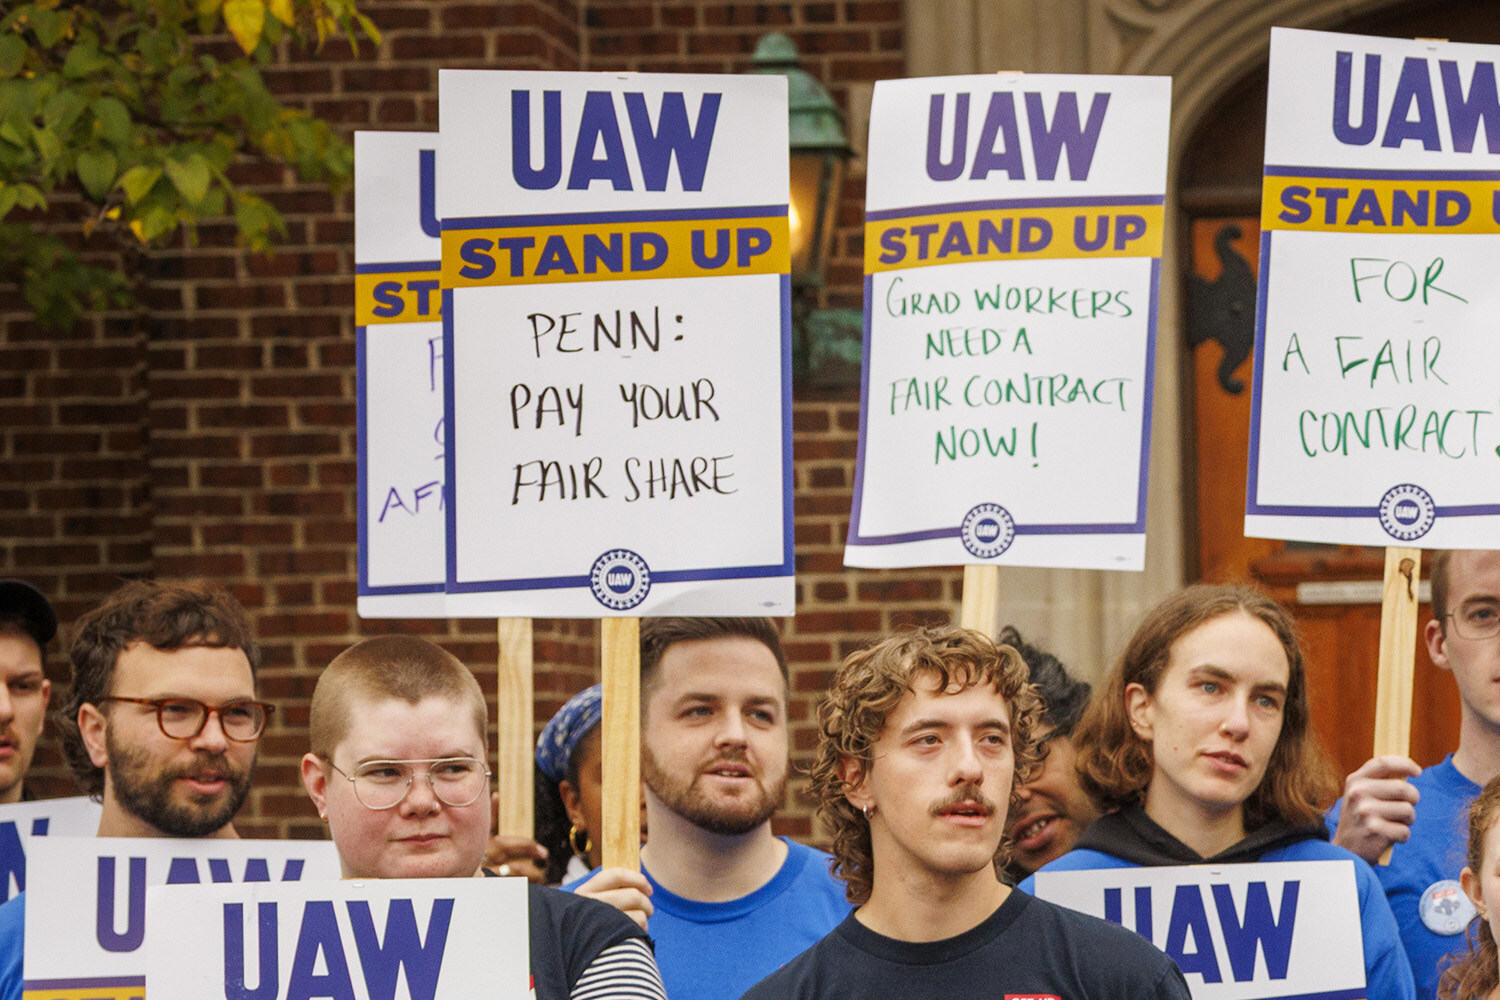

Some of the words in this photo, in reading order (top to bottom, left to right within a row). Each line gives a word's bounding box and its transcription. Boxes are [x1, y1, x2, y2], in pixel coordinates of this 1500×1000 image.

[511, 89, 723, 192] UAW
[925, 90, 1112, 183] UAW
[1278, 185, 1473, 227] STAND
[458, 231, 670, 281] STAND
[690, 227, 773, 270] UP
[878, 217, 1053, 265] STAND
[1073, 213, 1147, 252] UP
[886, 276, 961, 318] GRAD
[974, 283, 1133, 319] WORKERS
[1350, 256, 1469, 305] FOR
[526, 305, 686, 359] PENN:
[925, 328, 1002, 360] NEED
[1012, 327, 1034, 356] A
[1283, 332, 1311, 375] A
[1335, 335, 1449, 386] FAIR
[509, 382, 584, 438] PAY
[618, 377, 721, 429] YOUR
[889, 379, 952, 415] FAIR
[963, 373, 1132, 412] CONTRACT
[934, 422, 1040, 468] NOW!
[510, 455, 610, 505] FAIR
[623, 454, 739, 502] SHARE
[975, 521, 999, 541] UAW
[1393, 503, 1419, 521] UAW
[607, 571, 633, 589] UAW
